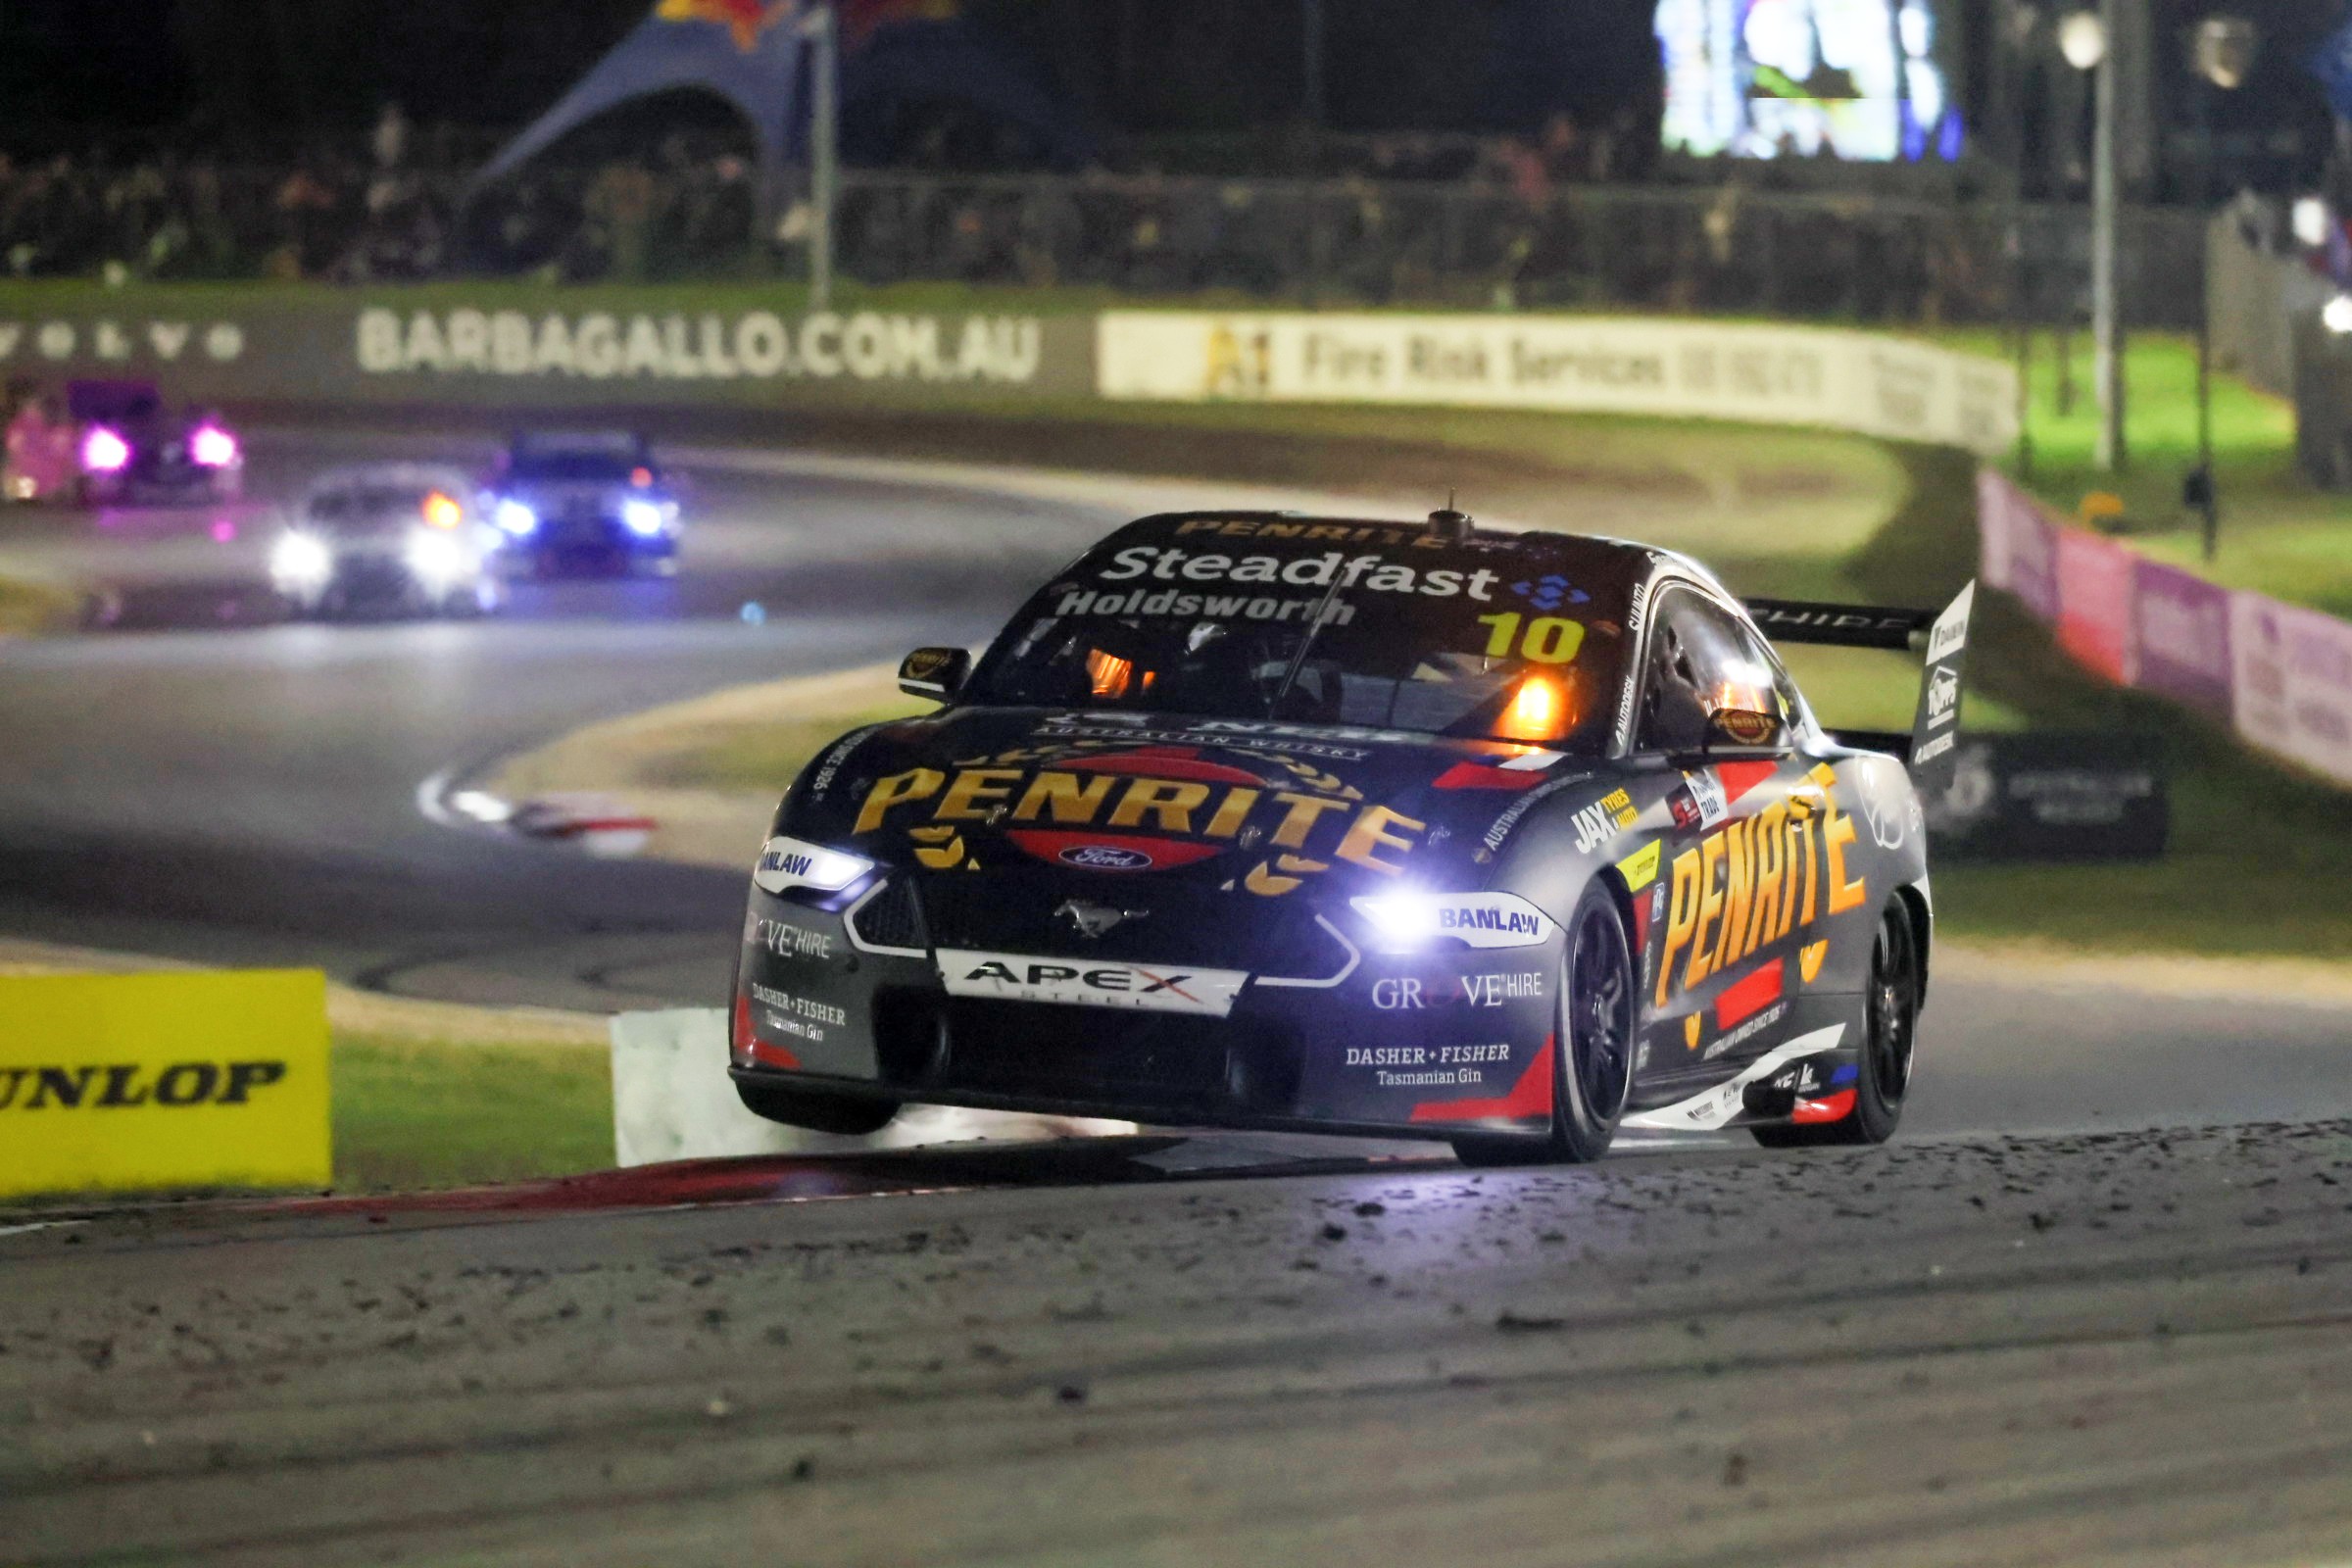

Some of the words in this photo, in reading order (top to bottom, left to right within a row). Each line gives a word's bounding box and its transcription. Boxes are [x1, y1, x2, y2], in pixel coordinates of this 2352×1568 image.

[358, 309, 1041, 380] BARBAGALLO.COM.AU
[1176, 520, 1448, 549] PENRITE
[1100, 547, 1499, 601] Steadfast
[1055, 589, 1357, 625] Holdsworth
[1478, 612, 1585, 663] 10
[1618, 675, 1635, 733] AUTODESK
[1249, 739, 1369, 760] WHISKY
[852, 768, 1427, 875] PENRITE
[1571, 801, 1617, 854] JAX
[759, 851, 812, 876] ANLAW
[1075, 848, 1136, 866] Ford
[1655, 761, 1866, 1008] PENRITE
[1439, 907, 1540, 936] BANLAW
[796, 929, 832, 958] HIRE
[964, 960, 1203, 1004] APEX
[1507, 972, 1543, 998] HIRE
[753, 983, 791, 1010] DASHER
[797, 998, 846, 1026] FISHER
[807, 1023, 824, 1042] Gin
[1347, 1048, 1426, 1065] DASHER
[1440, 1044, 1510, 1062] FISHER
[1377, 1070, 1456, 1086] Tasmanian
[1458, 1068, 1482, 1083] Gin
